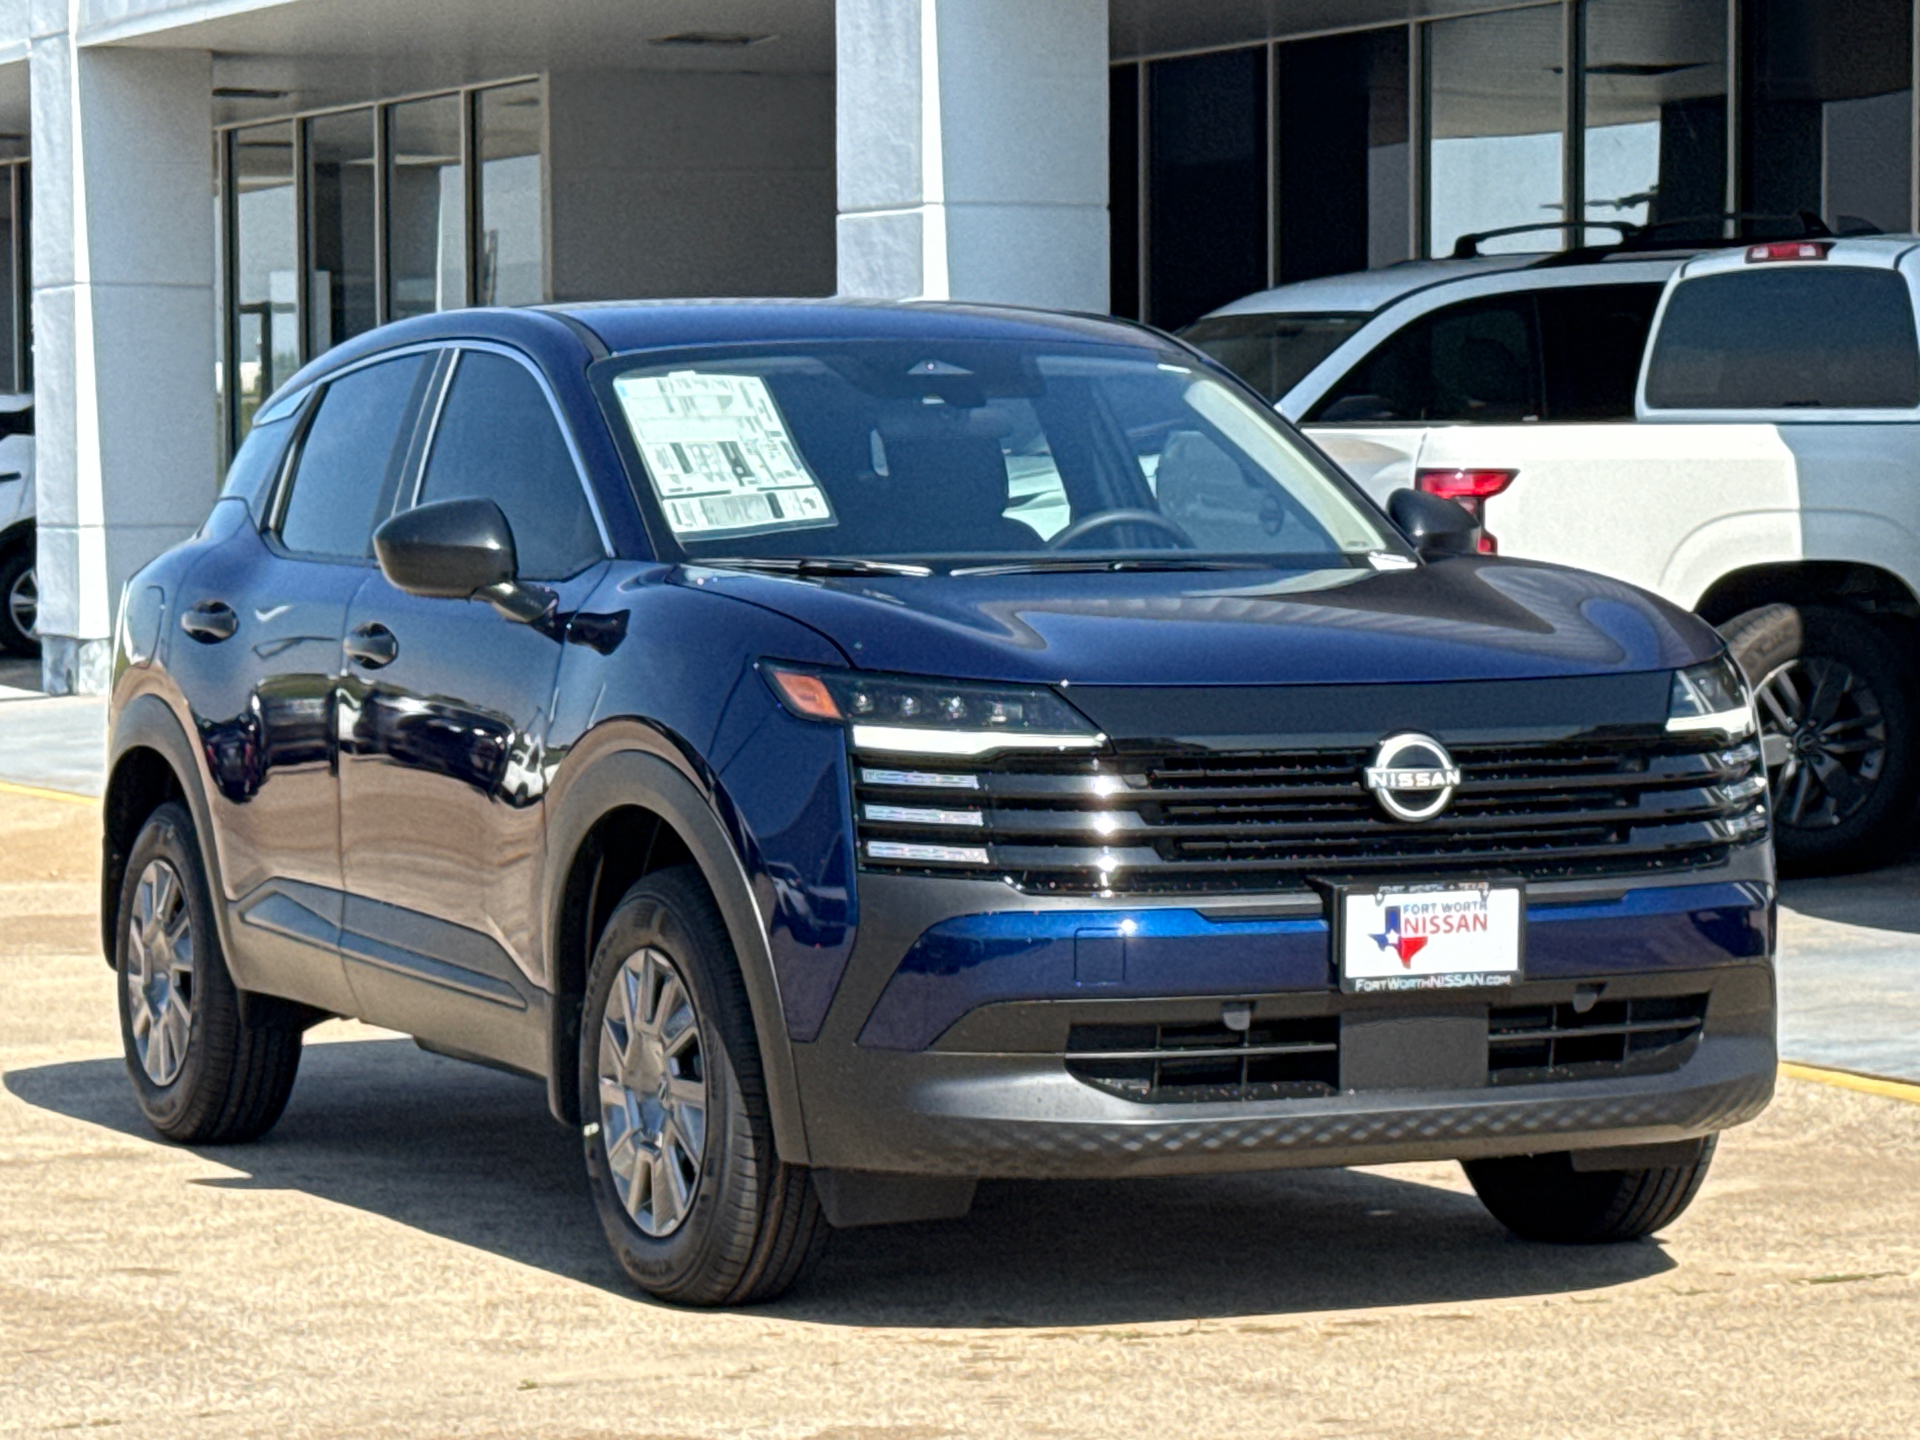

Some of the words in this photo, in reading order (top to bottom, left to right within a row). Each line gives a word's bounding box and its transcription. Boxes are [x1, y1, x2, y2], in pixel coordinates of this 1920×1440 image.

[1368, 770, 1460, 788] NISSAN
[1403, 903, 1437, 915] FORT
[1441, 901, 1488, 912] WORTH
[1404, 913, 1488, 934] NISSAN
